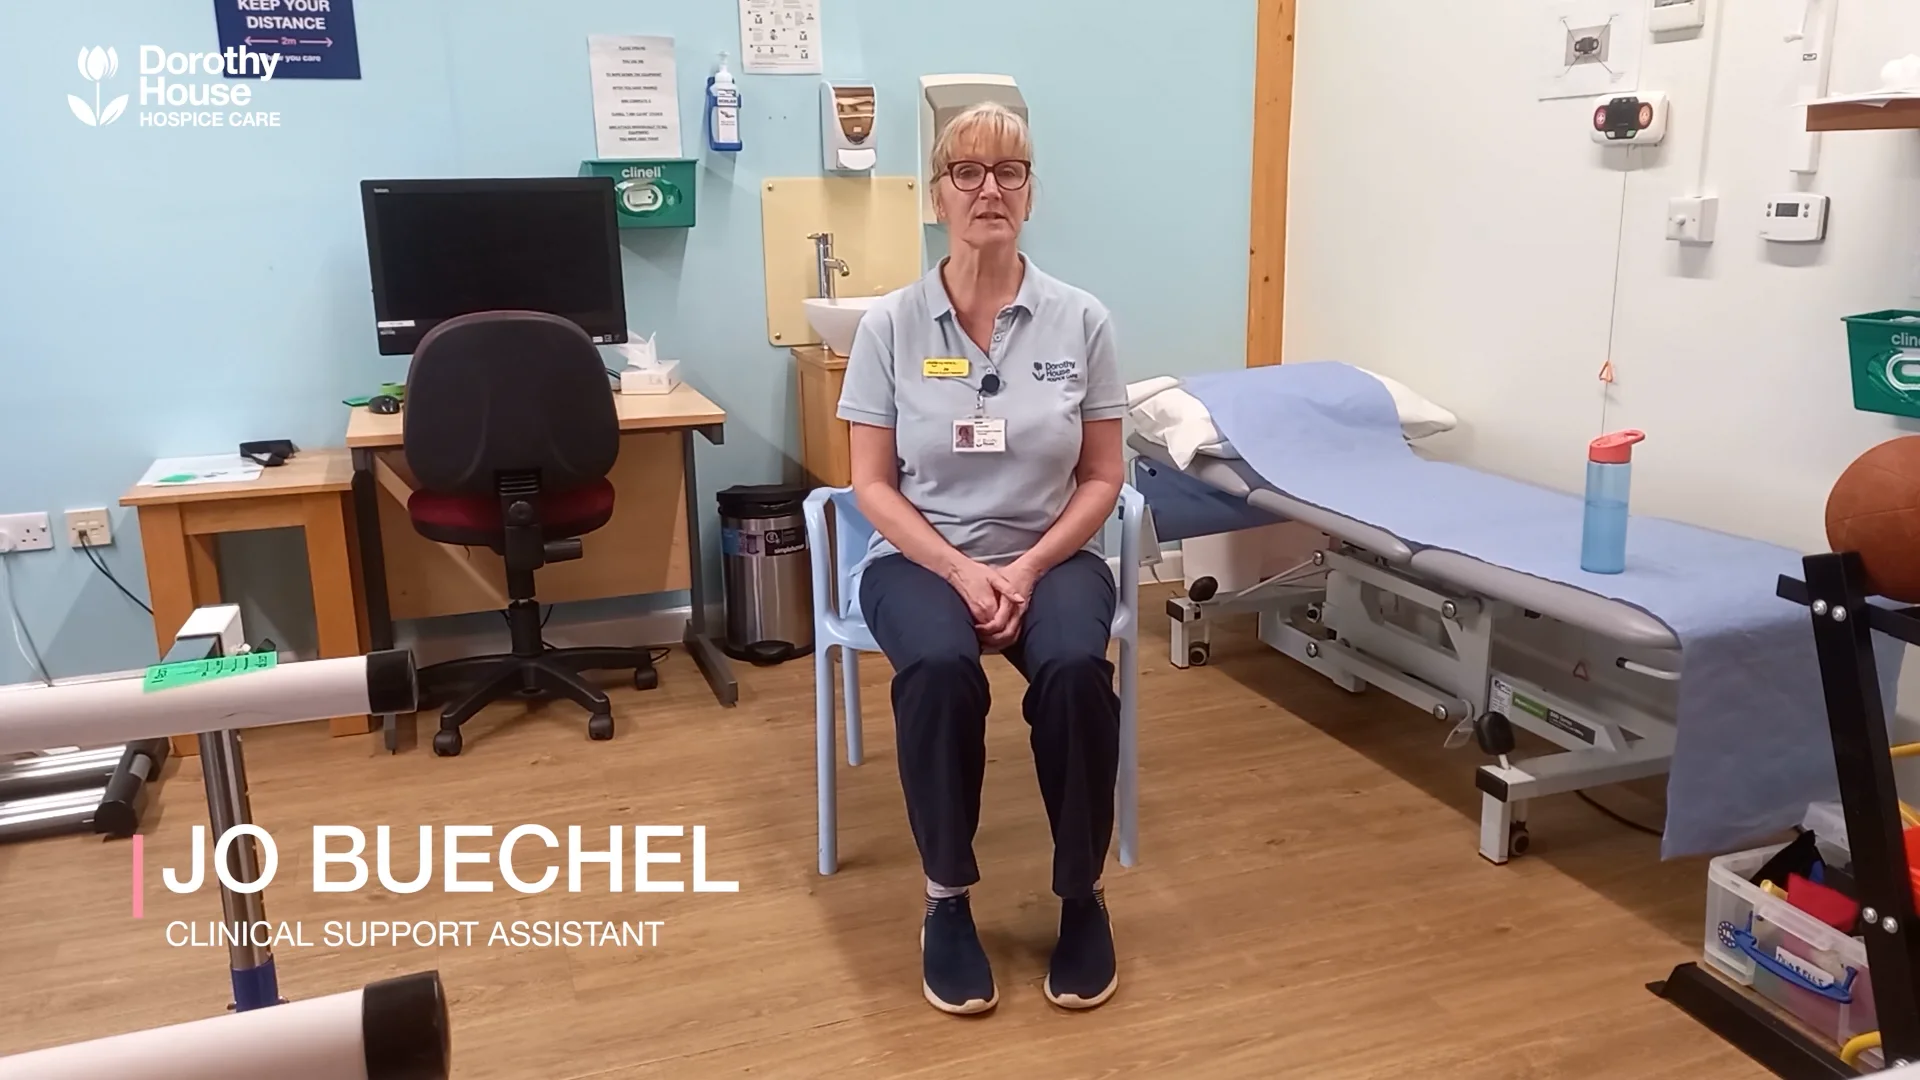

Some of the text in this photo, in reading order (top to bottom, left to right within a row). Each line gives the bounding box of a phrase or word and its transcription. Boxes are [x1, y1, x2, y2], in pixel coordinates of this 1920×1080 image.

[237, 0, 330, 12] KEEP YOUR
[246, 16, 326, 30] DISTANCE
[280, 37, 297, 46] 2m
[285, 55, 302, 63] you
[302, 55, 322, 63] care
[621, 166, 661, 178] clinell
[1045, 361, 1076, 370] Dorothy
[1046, 368, 1071, 377] House
